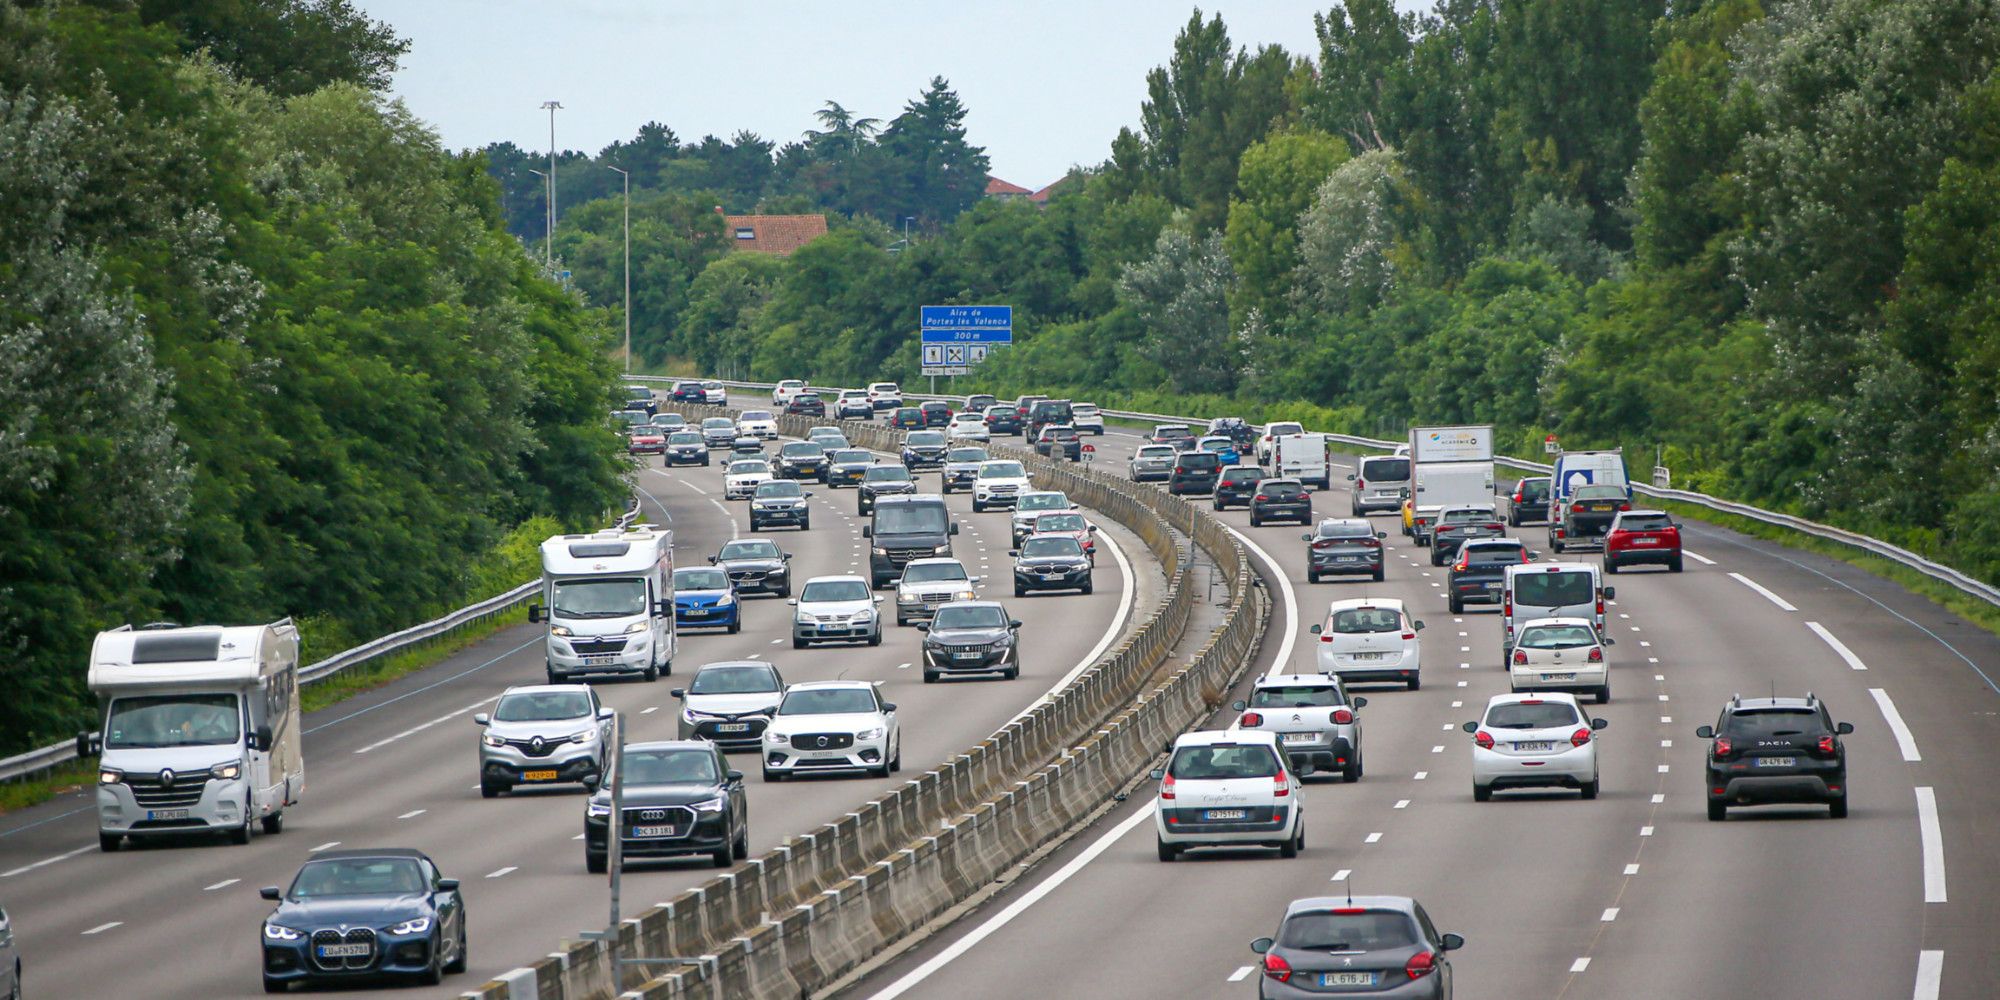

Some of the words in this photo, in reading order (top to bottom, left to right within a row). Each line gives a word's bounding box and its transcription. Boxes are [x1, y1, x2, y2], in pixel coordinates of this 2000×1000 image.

[926, 317, 954, 325] Portes
[974, 317, 1007, 325] Valence
[954, 332, 971, 340] 300
[1326, 975, 1338, 983] FL
[1340, 974, 1357, 983] 676
[1359, 974, 1371, 982] JT
